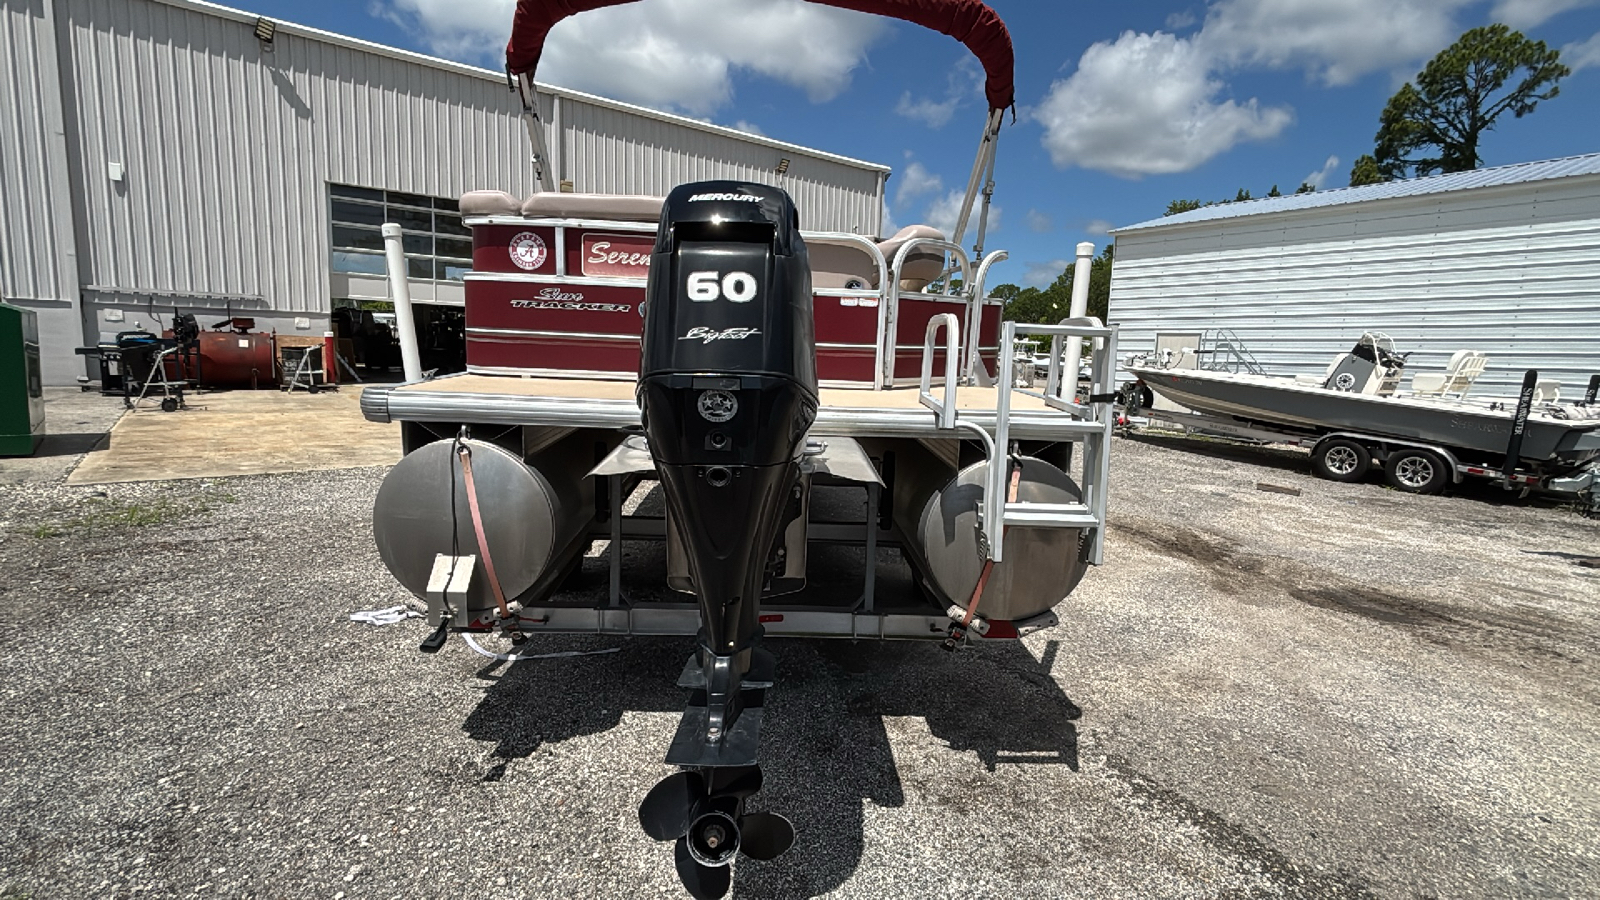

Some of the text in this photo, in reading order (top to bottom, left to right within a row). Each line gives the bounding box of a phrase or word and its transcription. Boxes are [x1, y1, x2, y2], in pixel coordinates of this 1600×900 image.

[688, 193, 765, 203] MERCURY
[588, 241, 652, 266] Seren
[533, 287, 584, 301] Sun
[687, 271, 758, 303] 60
[510, 299, 632, 313] TRACKER
